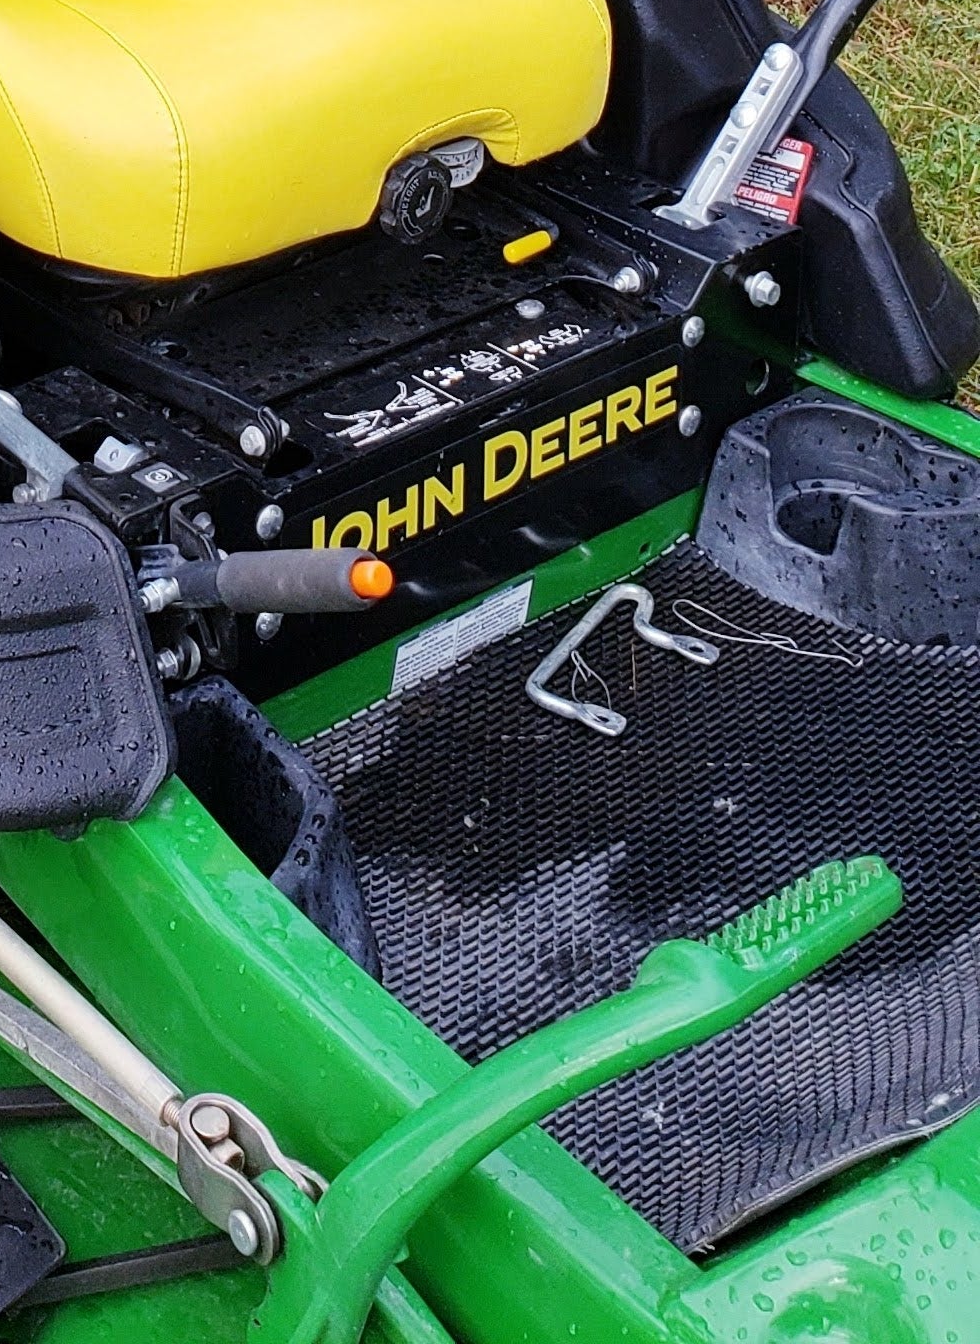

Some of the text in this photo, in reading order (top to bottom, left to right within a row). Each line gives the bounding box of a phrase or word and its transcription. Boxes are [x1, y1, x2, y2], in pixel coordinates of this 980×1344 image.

[780, 137, 803, 152] GER
[737, 185, 778, 206] PELIGRO
[483, 365, 678, 502] DEERE
